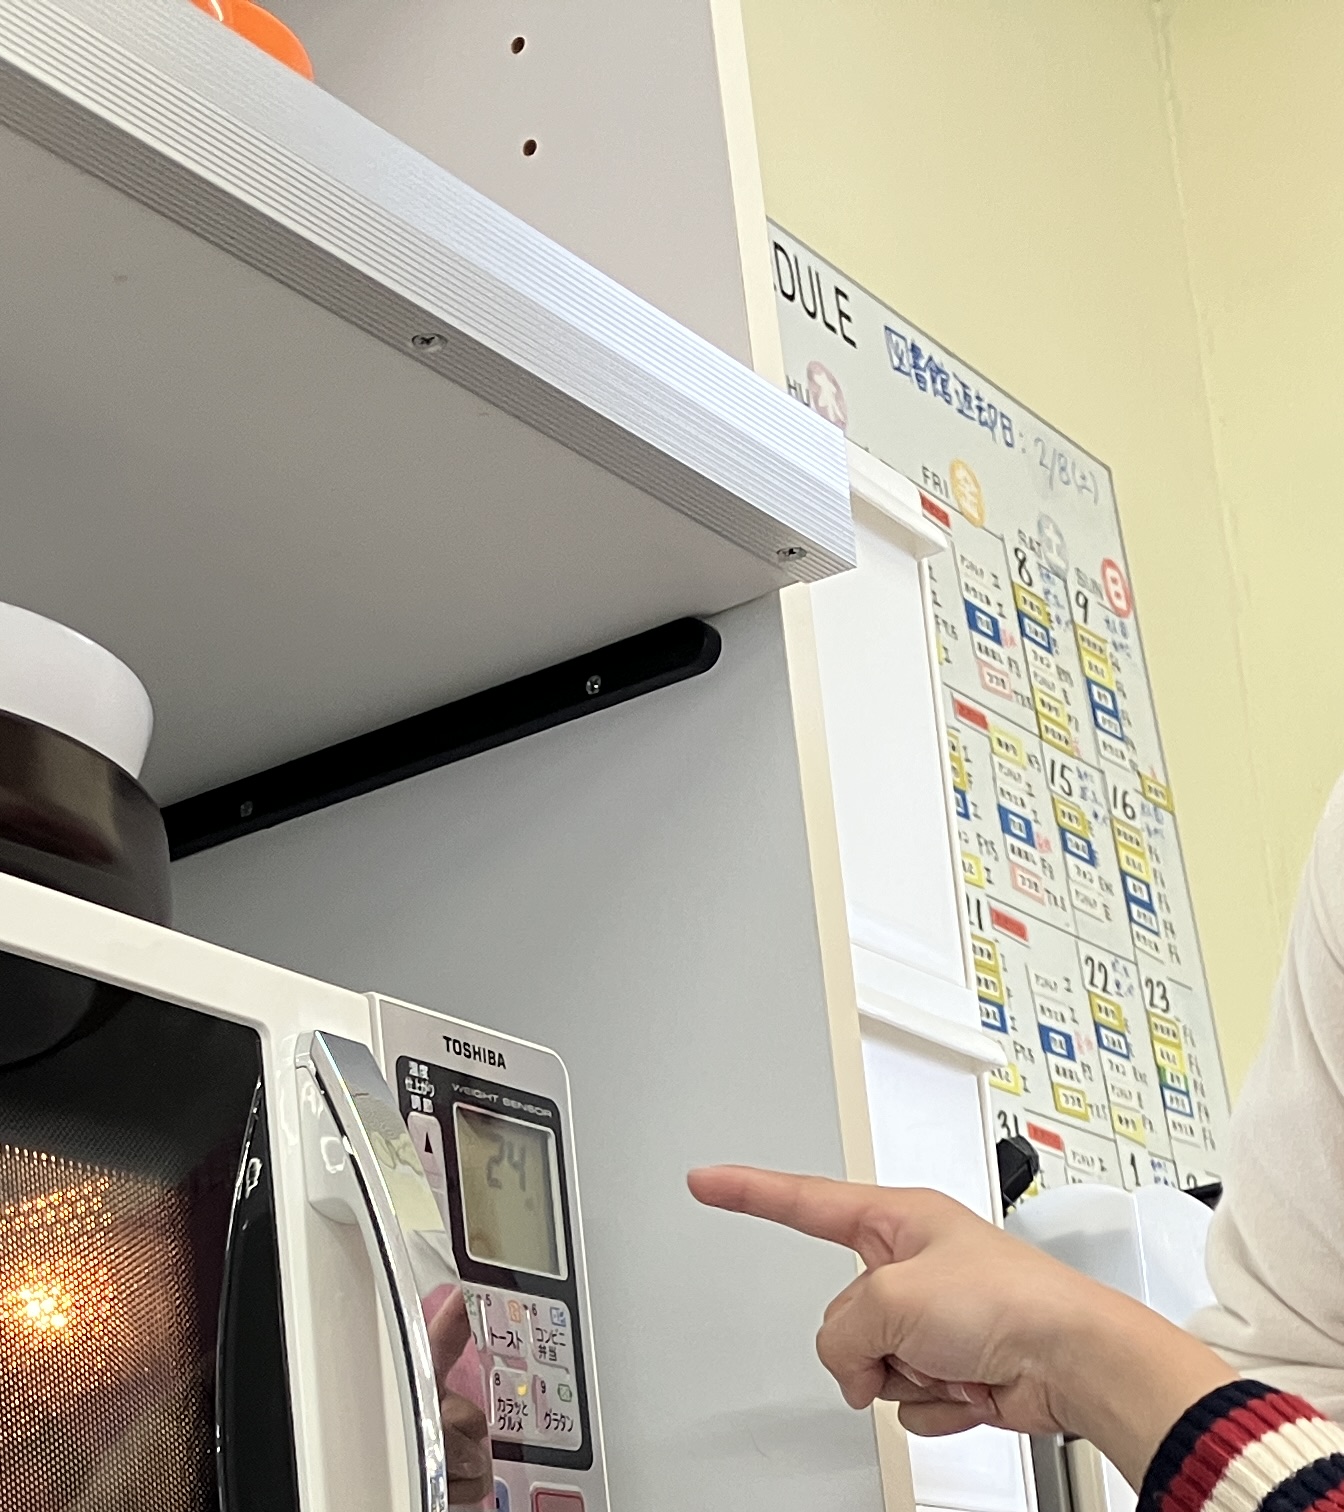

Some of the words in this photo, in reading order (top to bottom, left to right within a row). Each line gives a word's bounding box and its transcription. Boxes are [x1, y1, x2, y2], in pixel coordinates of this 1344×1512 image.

[772, 241, 858, 349] DULE
[922, 465, 949, 499] FRI
[1014, 547, 1033, 588] 8
[1075, 590, 1089, 625] 9
[1049, 758, 1074, 797] 15
[1112, 784, 1136, 820] 16
[1085, 955, 1113, 996] 22
[1145, 976, 1171, 1014] 23
[443, 1035, 507, 1070] TOSHIBA
[451, 1083, 499, 1103] WEIGHT
[502, 1097, 553, 1119] SENSOR
[486, 1293, 492, 1307] 5
[532, 1303, 538, 1317] 6
[490, 1329, 523, 1351] トースト
[536, 1327, 566, 1347] コンビニ
[494, 1372, 501, 1387] 8
[541, 1380, 547, 1394] 9
[498, 1415, 524, 1433] グルメ
[544, 1410, 574, 1433] グラタン
